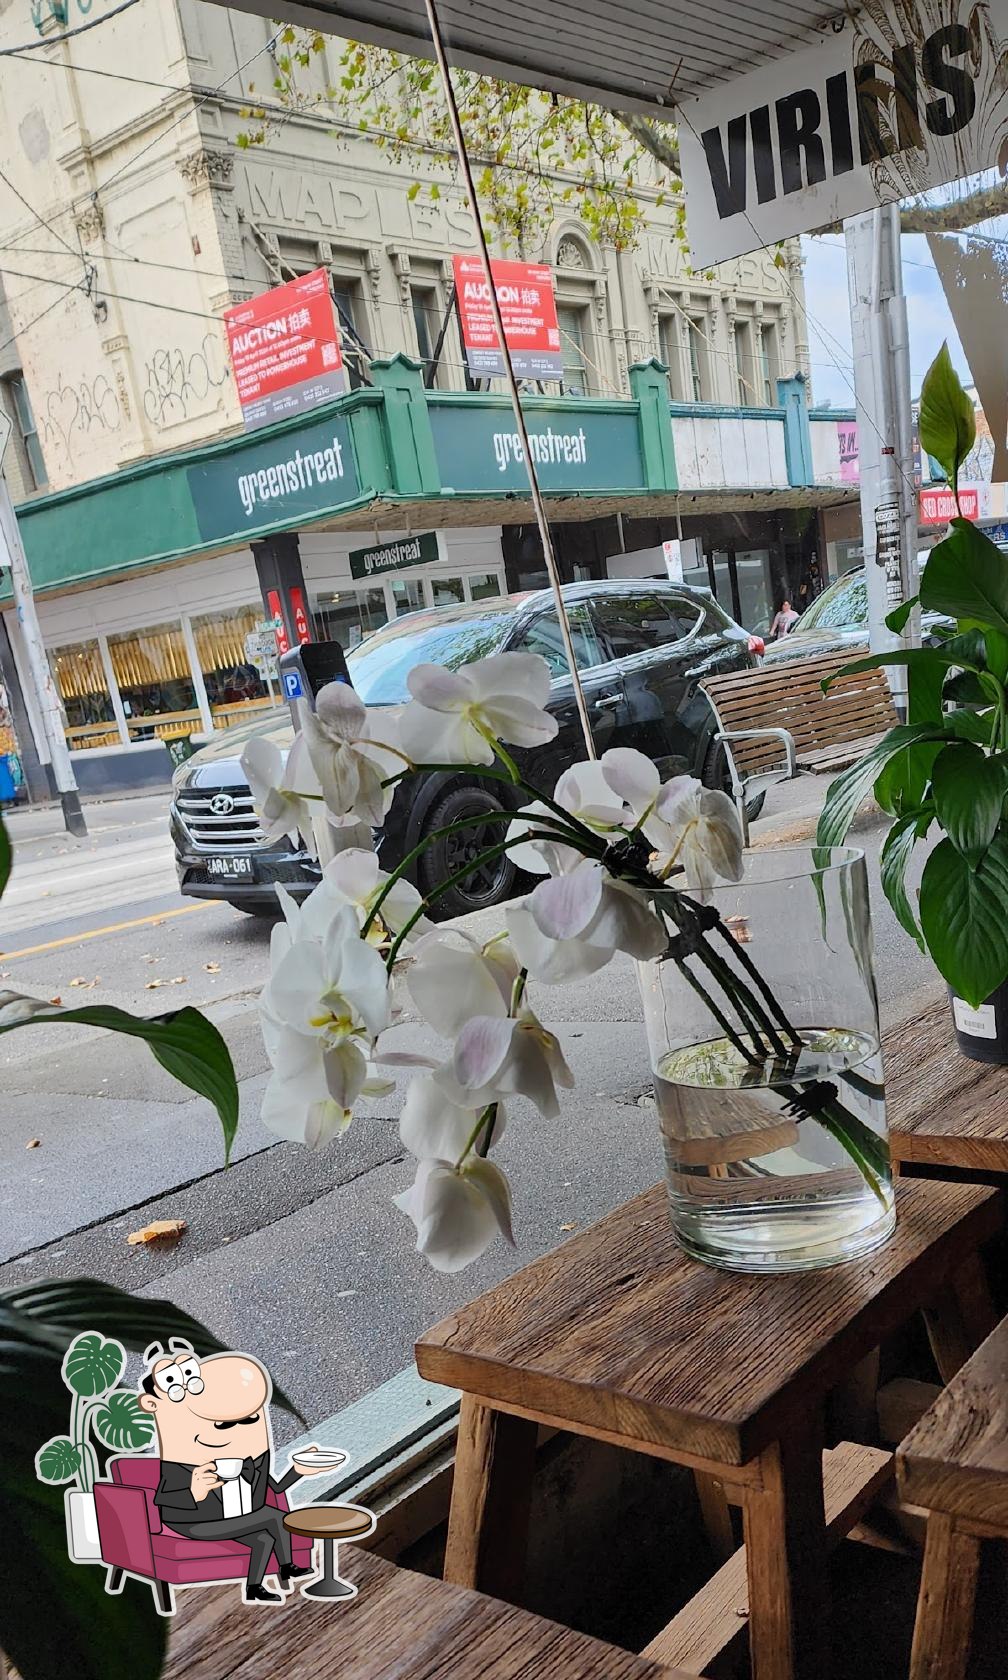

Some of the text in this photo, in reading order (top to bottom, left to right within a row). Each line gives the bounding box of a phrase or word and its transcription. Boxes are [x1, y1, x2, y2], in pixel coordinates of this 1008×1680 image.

[244, 165, 480, 249] MAPLES
[232, 317, 288, 355] AUCTION
[287, 307, 312, 334] 拍卖
[493, 427, 587, 472] grenstreat
[238, 437, 344, 516] greenstreat
[363, 538, 421, 575] greenstreat
[286, 675, 299, 696] P
